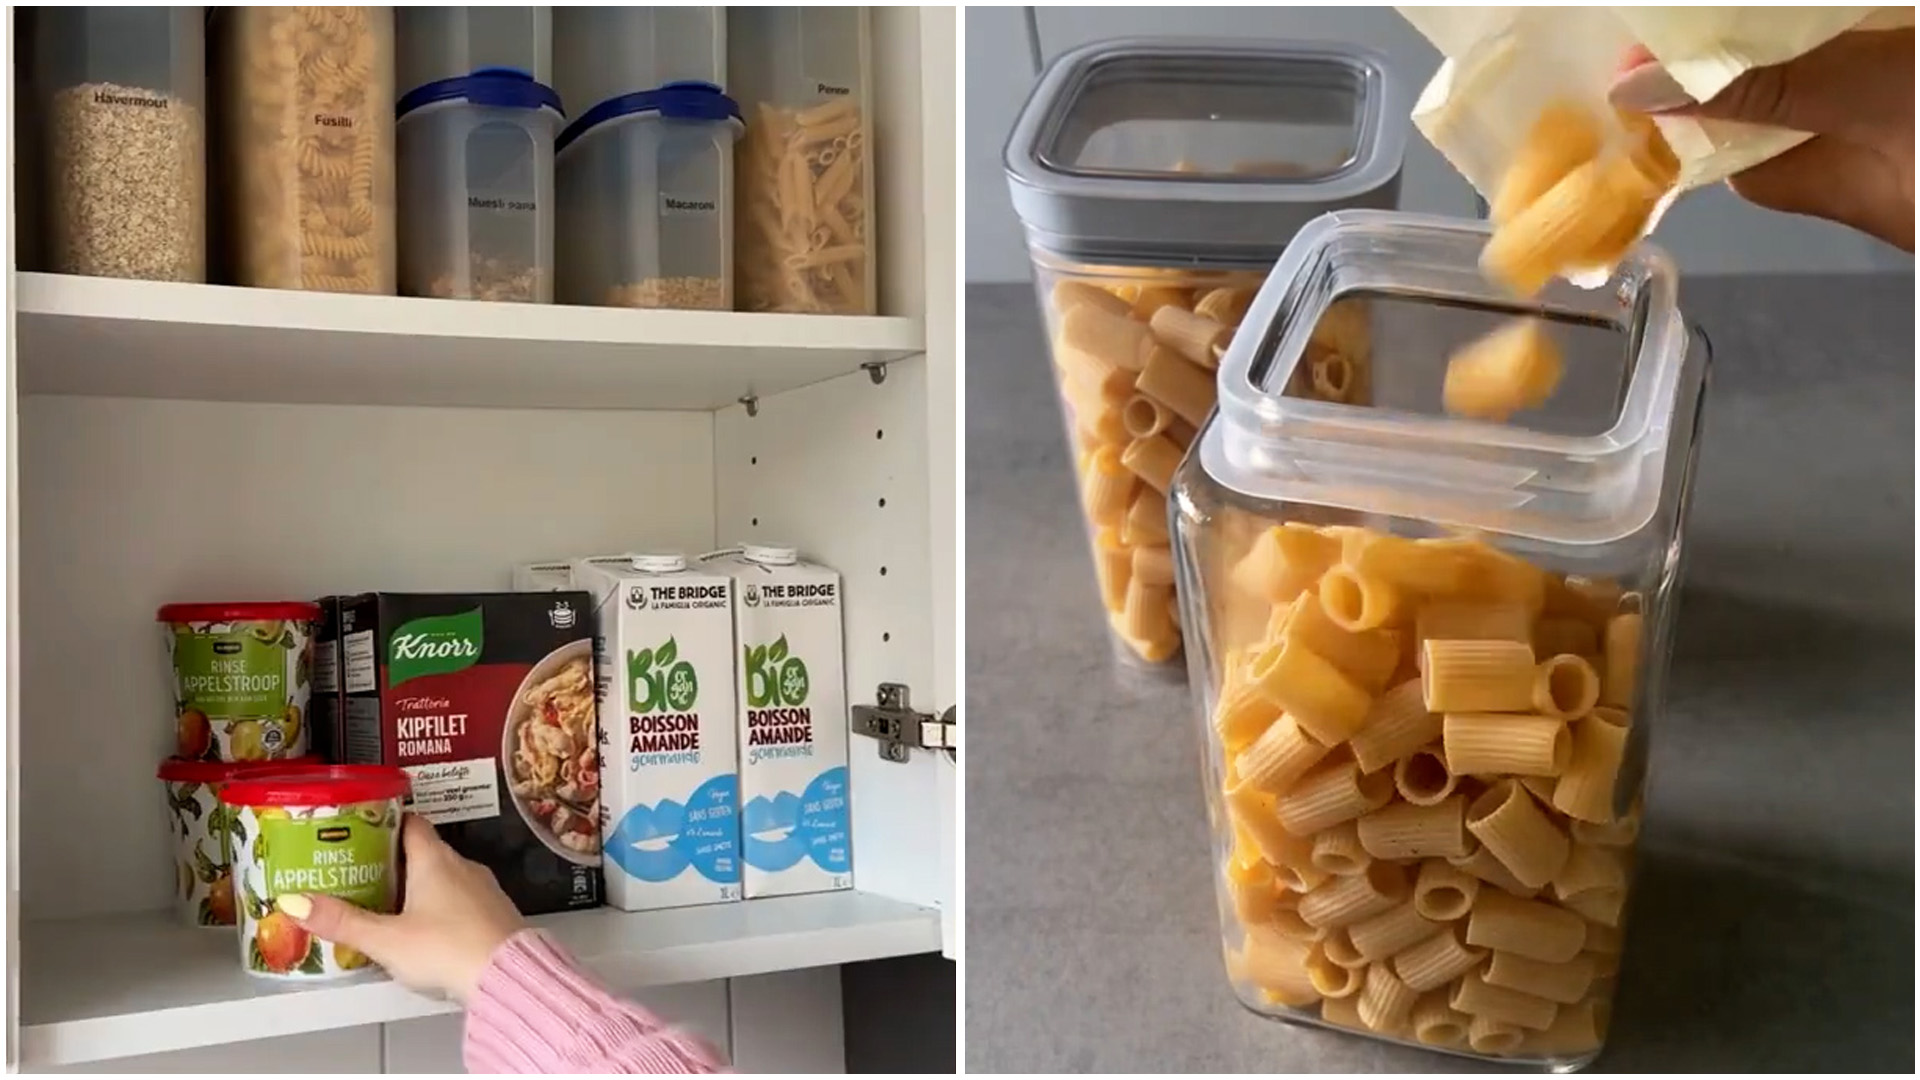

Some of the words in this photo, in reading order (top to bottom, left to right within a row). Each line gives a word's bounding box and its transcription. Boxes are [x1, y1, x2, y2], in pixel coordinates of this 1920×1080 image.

[94, 91, 168, 109] Havermout
[314, 114, 352, 128] Fusilli
[468, 197, 505, 209] Muesli
[665, 197, 715, 211] Macaroni
[650, 588, 676, 600] THE
[679, 586, 726, 599] BRIDGE
[762, 586, 785, 598] THE
[788, 584, 835, 597] BRIDGE
[392, 633, 478, 659] Knorr
[211, 660, 247, 673] RINSE
[184, 675, 280, 692] APPELSTROOP
[395, 697, 450, 711] Trattoria
[397, 714, 467, 739] KIPFILET
[630, 714, 698, 734] BOISSON
[748, 708, 811, 728] BOISSON
[631, 733, 699, 753] AMANDE
[749, 726, 813, 746] AMANDE
[399, 738, 452, 757] ROMANA
[749, 744, 813, 765] gourmande
[631, 750, 700, 772] gourmande
[313, 848, 355, 866] RINSE
